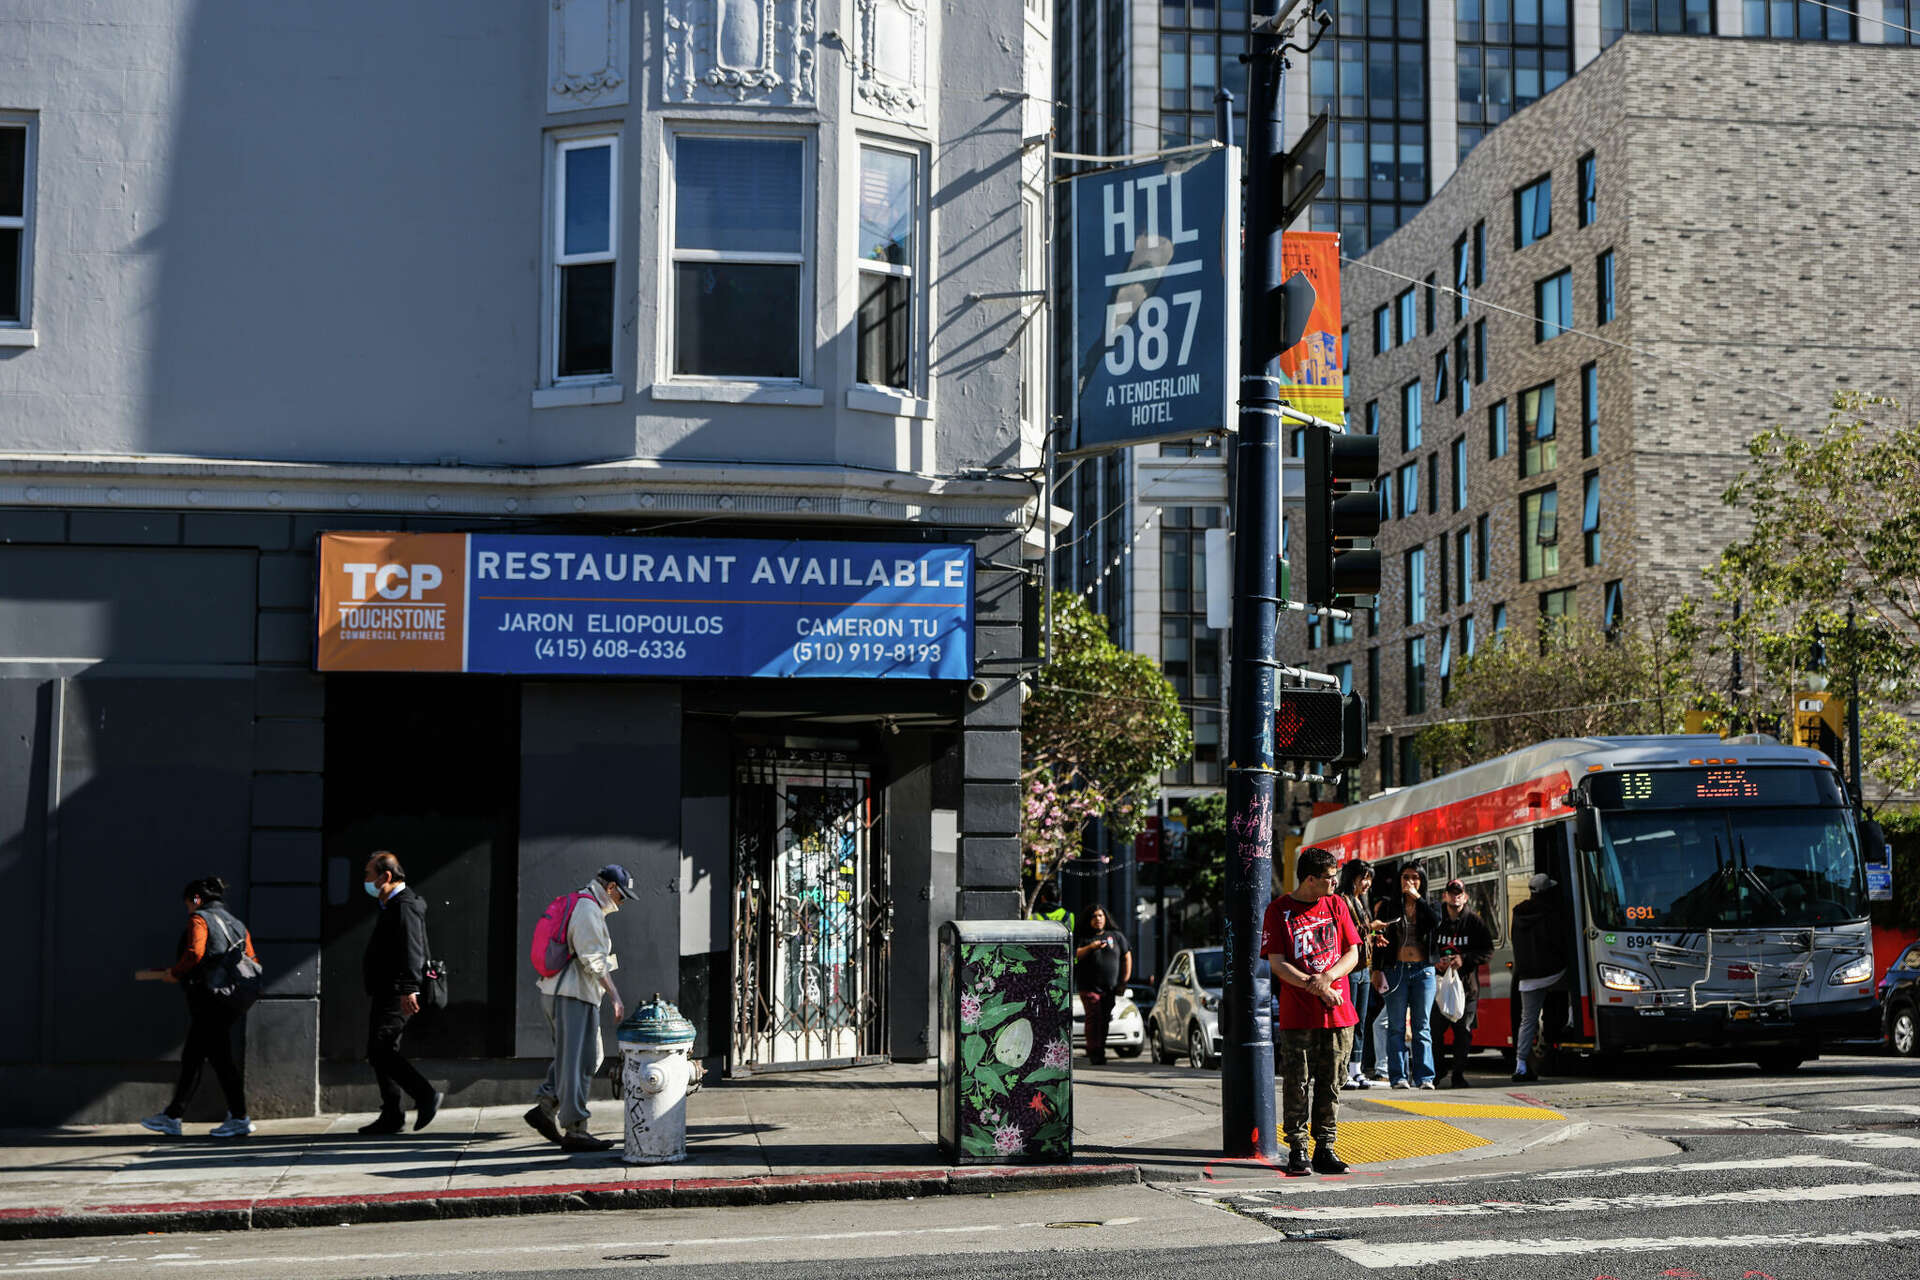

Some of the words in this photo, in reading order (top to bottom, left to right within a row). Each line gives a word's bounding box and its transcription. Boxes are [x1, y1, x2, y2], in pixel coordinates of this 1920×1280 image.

[1103, 171, 1199, 257] HTL
[1104, 289, 1203, 376] 587
[1105, 385, 1116, 407] A
[1118, 373, 1201, 405] TENDERLOIN
[1131, 401, 1174, 426] HOTEL
[477, 551, 737, 584] RESTAURANT
[750, 556, 965, 588] AVAILABLE
[343, 563, 443, 600] TCP
[338, 608, 446, 630] TOUCHSTONE
[498, 612, 574, 633] JARON
[587, 613, 724, 635] ELIOPOULOS
[796, 617, 904, 637] CAMERON
[909, 619, 938, 638] TU
[339, 630, 398, 641] COMMERCIAL
[400, 631, 446, 641] PARTNERS
[534, 638, 587, 660] (415)
[592, 639, 687, 660] 608-6336
[792, 641, 844, 664] (510)
[848, 643, 942, 663] 919-8193
[1626, 906, 1656, 919] 691
